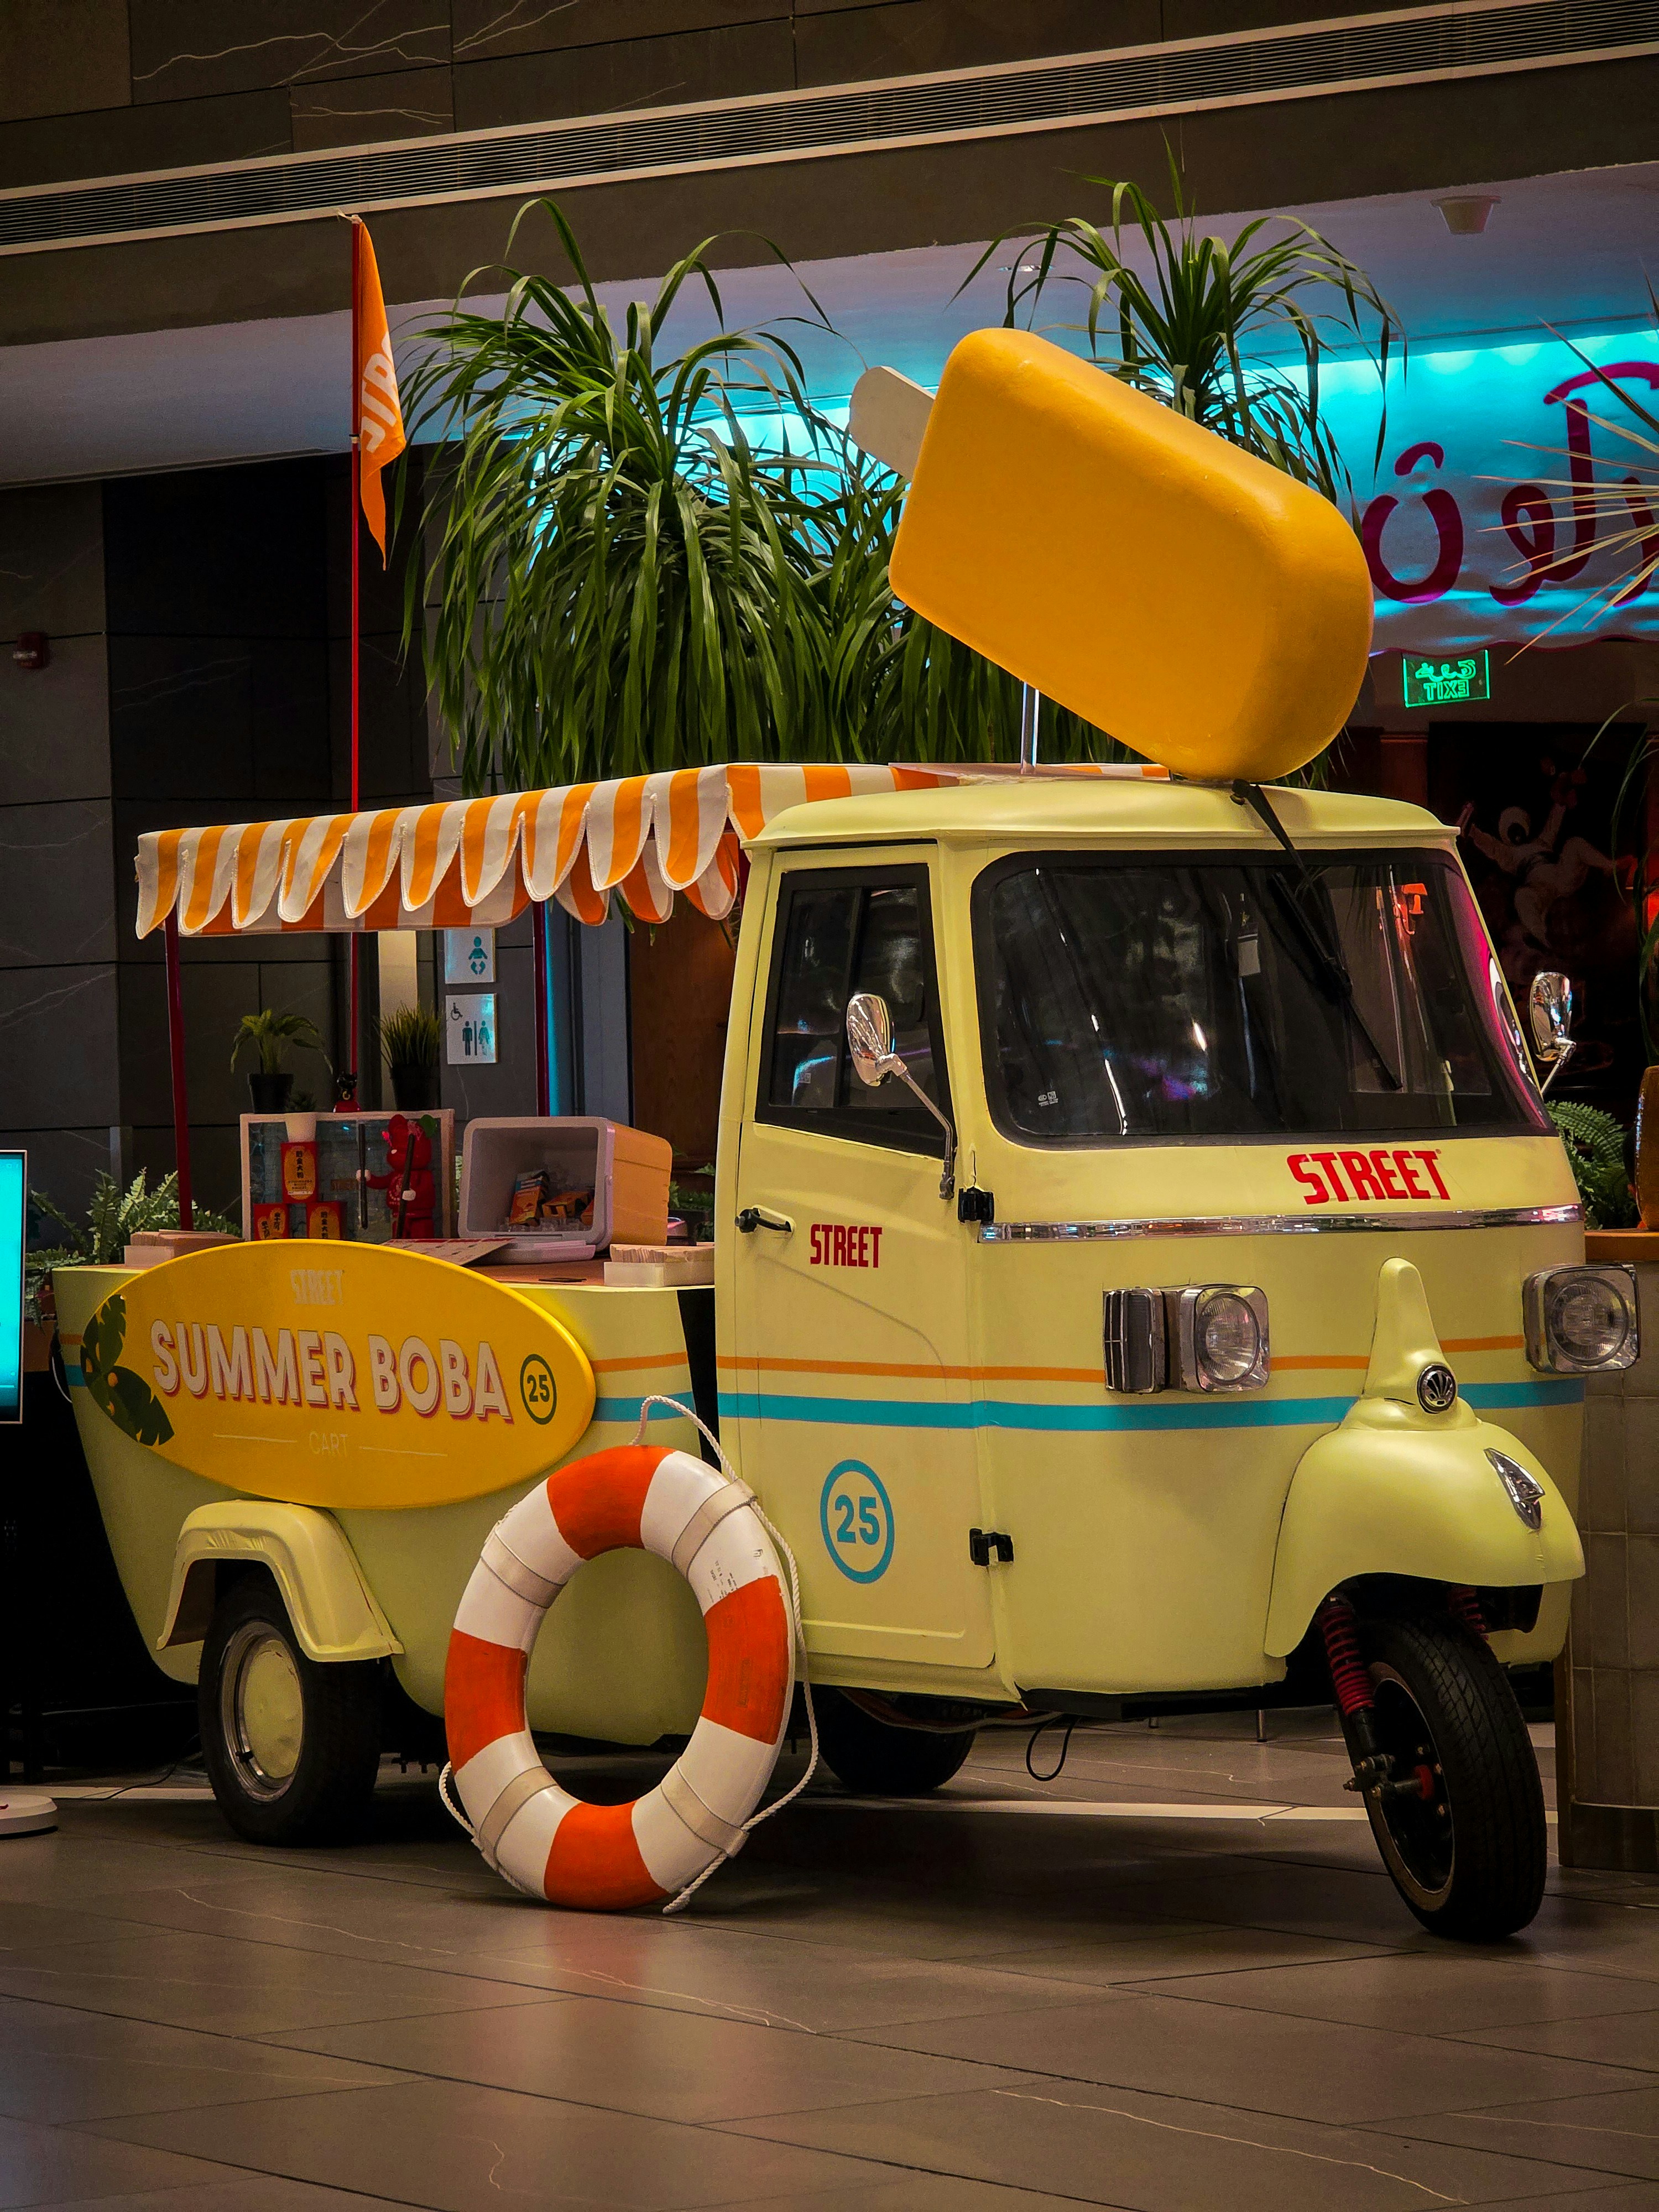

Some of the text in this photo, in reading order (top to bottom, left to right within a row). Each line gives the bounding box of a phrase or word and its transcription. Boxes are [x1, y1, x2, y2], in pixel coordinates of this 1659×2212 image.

[1287, 1150, 1450, 1204] STREET
[810, 1224, 883, 1267] STREET
[290, 1269, 343, 1305] STREET
[150, 1318, 514, 1425] SUMMER BOBA
[527, 1374, 550, 1402] 25
[309, 1431, 348, 1456] CART
[834, 1494, 880, 1545] 25
